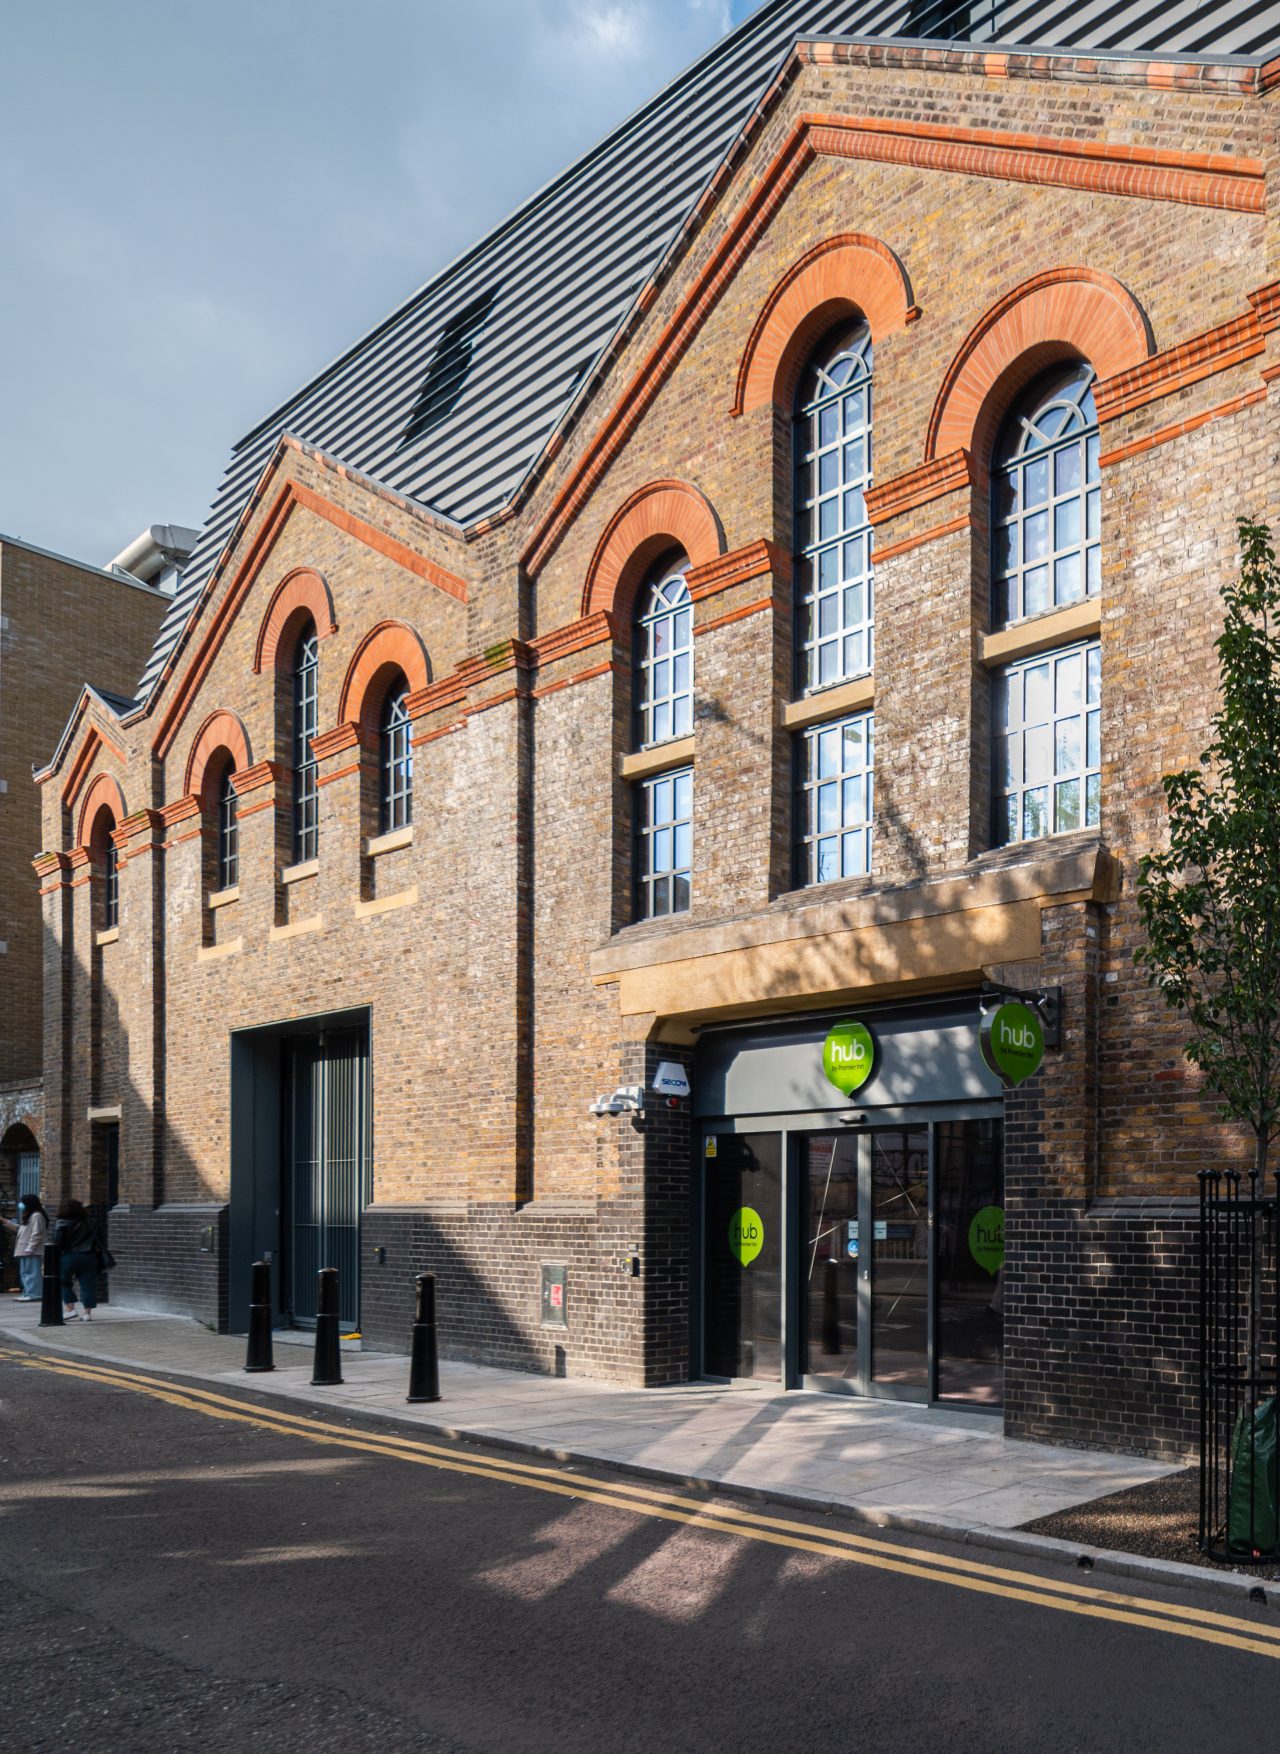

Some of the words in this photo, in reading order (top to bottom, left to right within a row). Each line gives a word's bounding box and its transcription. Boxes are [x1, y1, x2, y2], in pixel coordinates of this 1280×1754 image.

[1000, 1019, 1035, 1048] hub
[831, 1038, 865, 1062] hub
[662, 1078, 687, 1087] SECOM
[735, 1222, 757, 1239] hub
